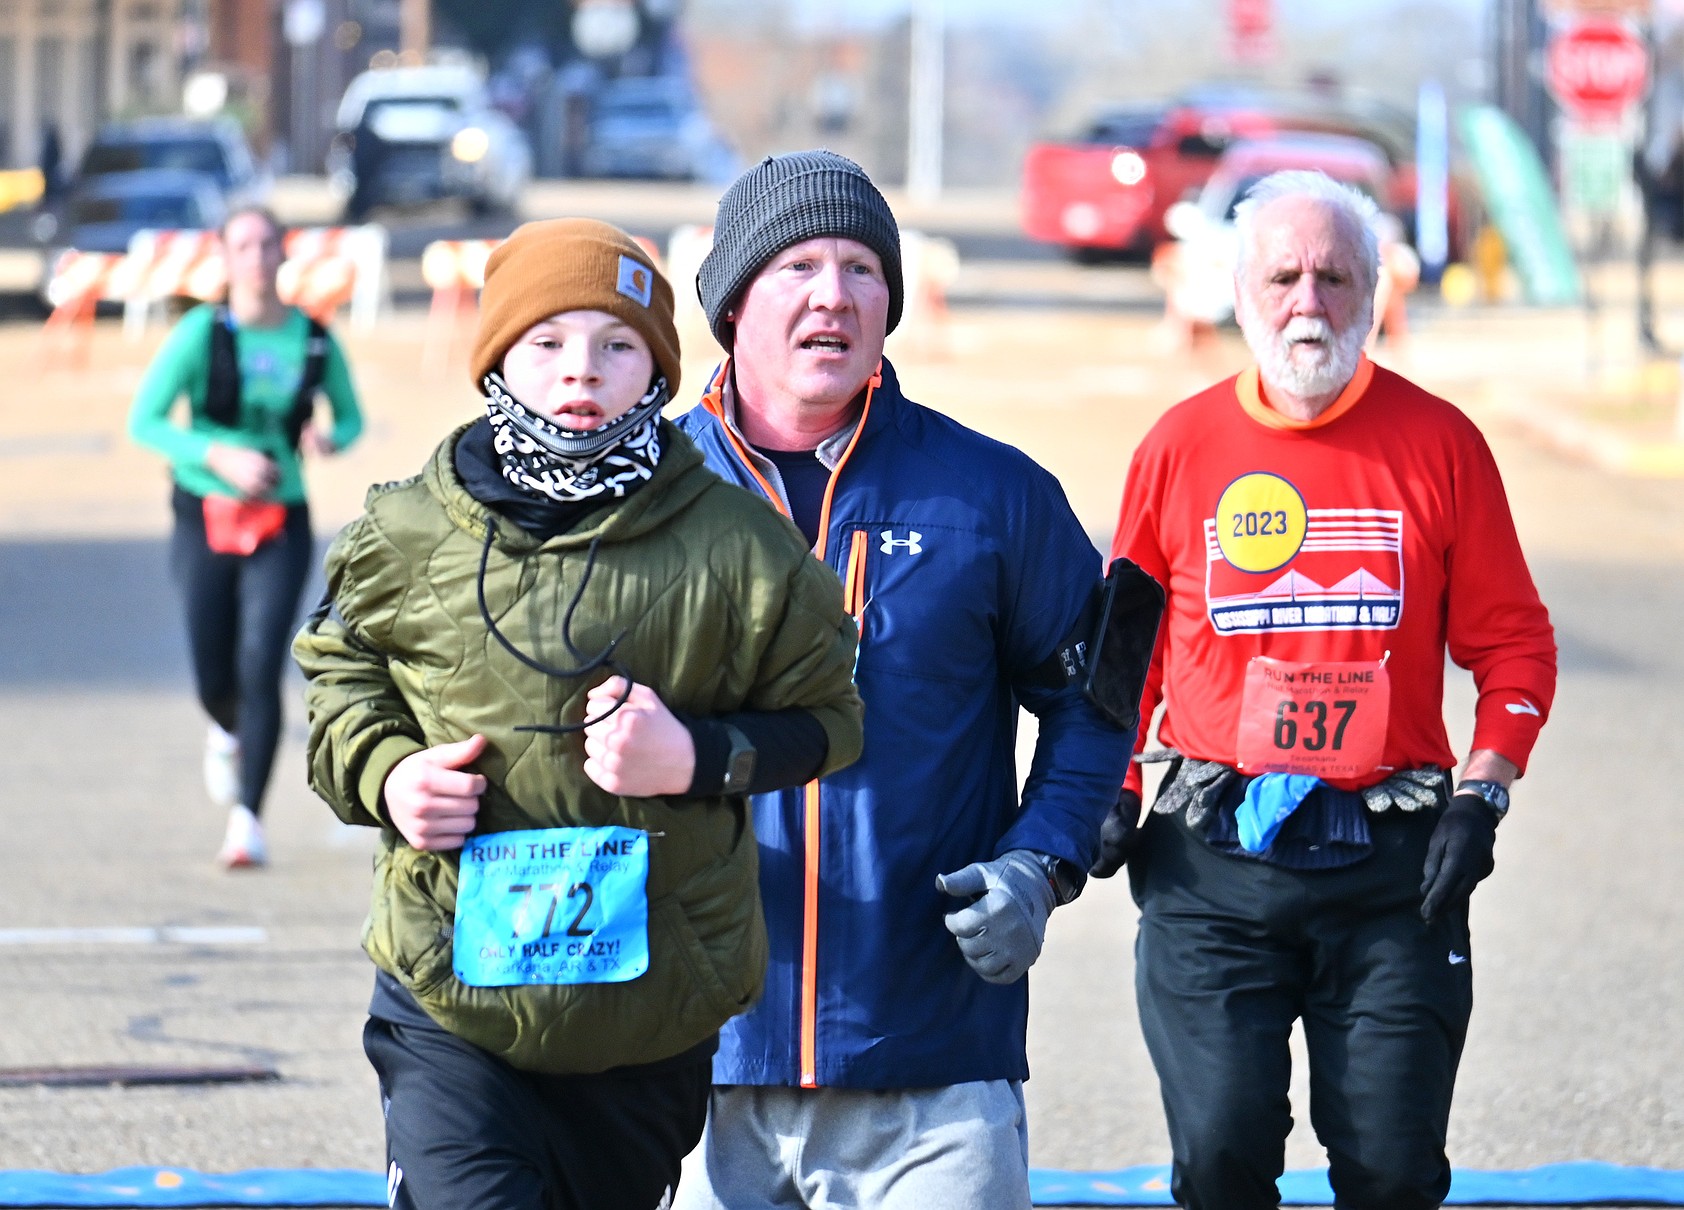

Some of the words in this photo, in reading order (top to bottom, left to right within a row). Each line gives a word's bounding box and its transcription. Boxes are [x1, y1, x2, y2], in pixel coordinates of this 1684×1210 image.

[1233, 511, 1288, 537] 2023
[1359, 606, 1371, 623] &
[1264, 668, 1295, 683] RUN
[1301, 672, 1333, 684] THE
[1338, 671, 1374, 684] LINE
[1273, 700, 1357, 751] 637
[472, 844, 517, 861] RUN
[526, 842, 571, 859] THE
[581, 839, 634, 856] LINE
[590, 860, 629, 874] Relay
[508, 882, 594, 938] 772
[480, 944, 515, 959] ONLY
[523, 942, 559, 957] HALF
[567, 939, 620, 956] CRAZY!
[587, 960, 597, 971] &
[602, 958, 621, 970] TX
